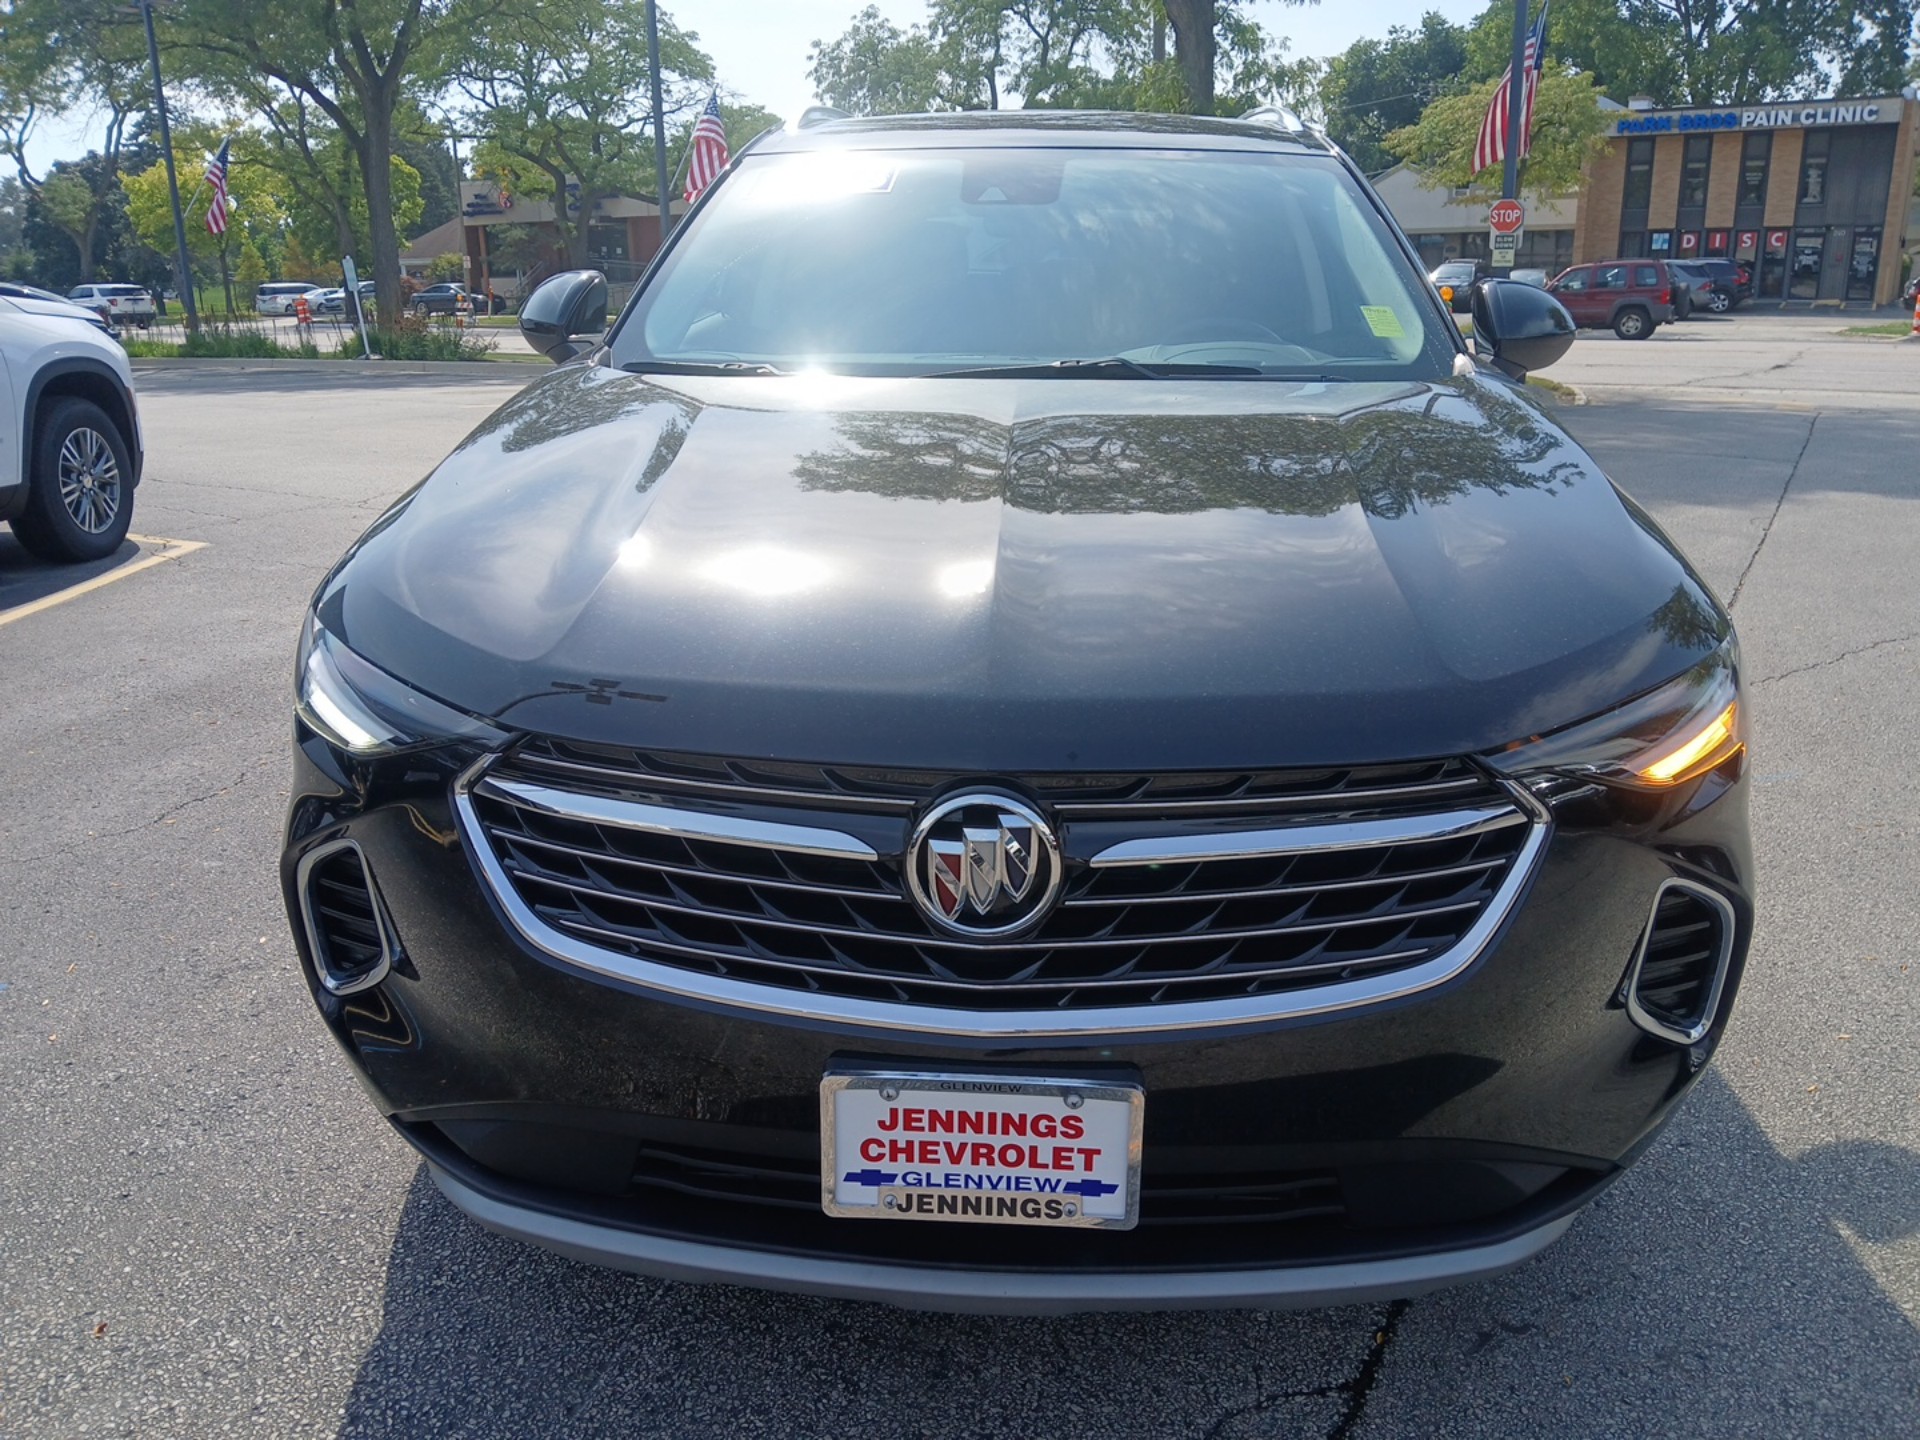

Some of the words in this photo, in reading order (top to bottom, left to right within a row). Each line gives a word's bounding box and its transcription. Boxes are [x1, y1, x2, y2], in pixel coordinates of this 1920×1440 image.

[1617, 116, 1672, 134] PARK
[1678, 112, 1737, 131] BROS
[1741, 109, 1792, 128] PAIN
[1800, 104, 1879, 125] CLINIC
[1491, 209, 1520, 223] STOP
[940, 1081, 1023, 1094] GLENVIEW
[877, 1107, 1085, 1139] JENNINGS
[859, 1138, 1102, 1172] CHEVROLET
[901, 1171, 1062, 1193] GLENVIEW
[896, 1192, 1064, 1220] JENNINGS
